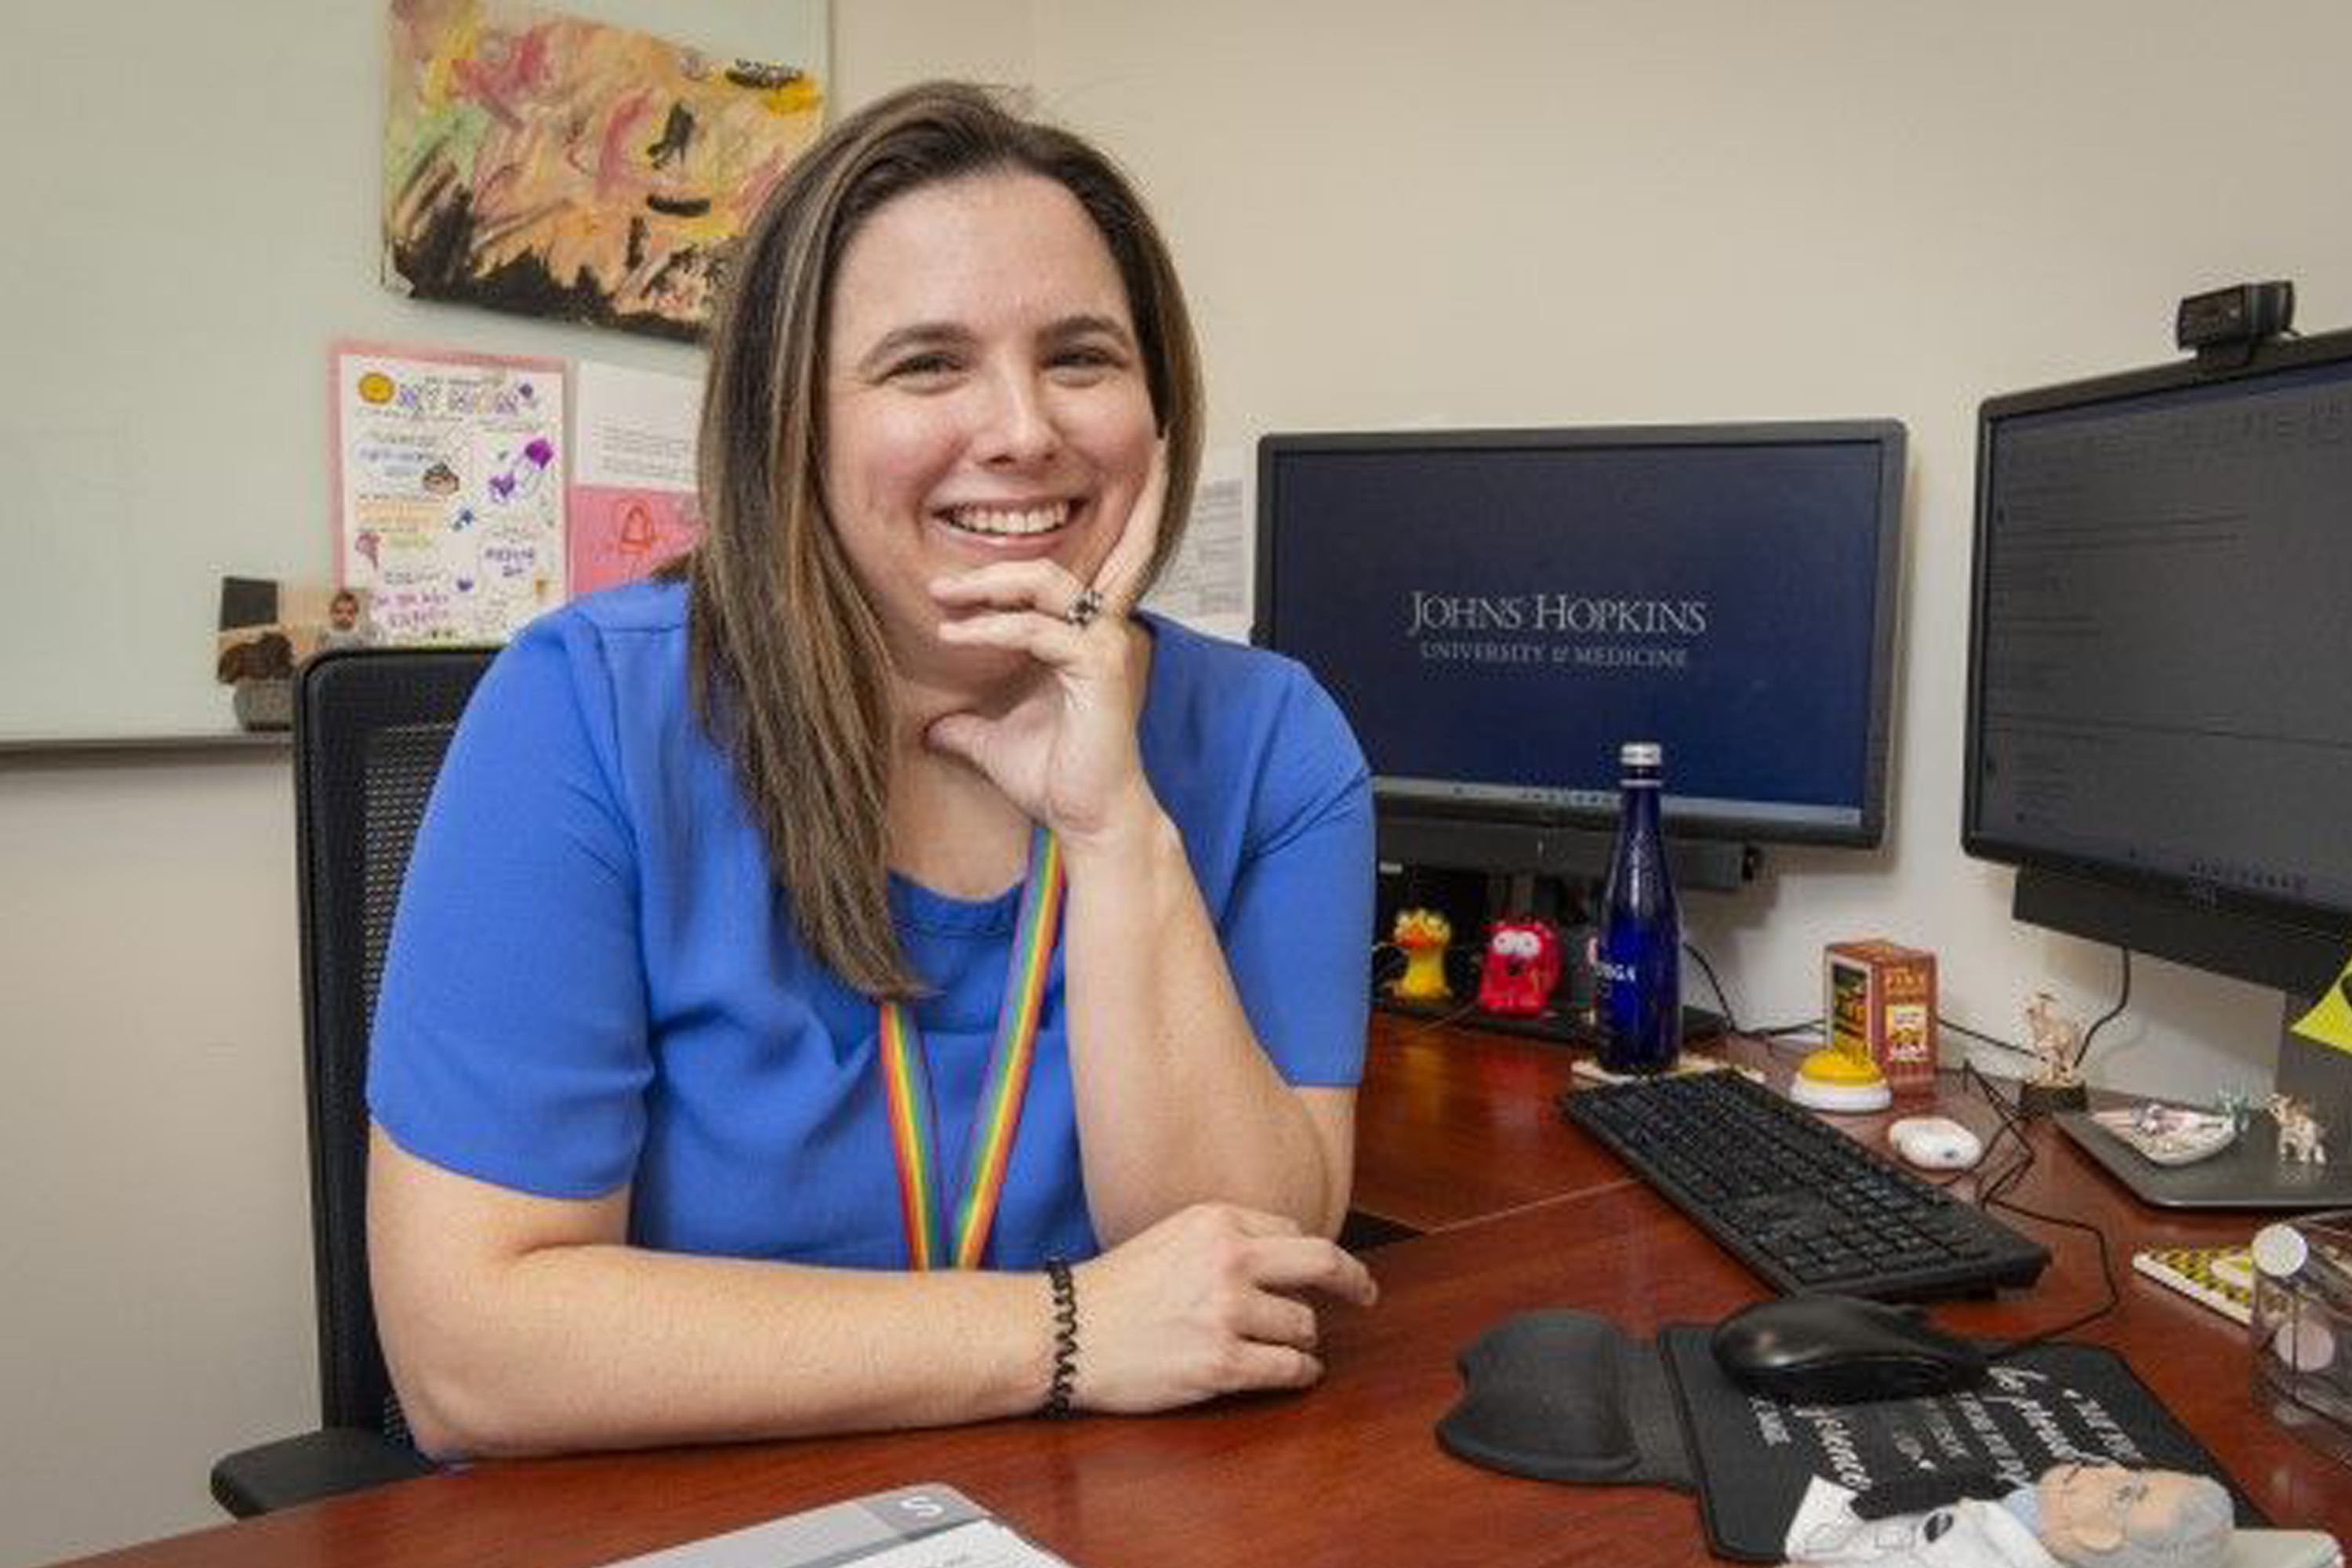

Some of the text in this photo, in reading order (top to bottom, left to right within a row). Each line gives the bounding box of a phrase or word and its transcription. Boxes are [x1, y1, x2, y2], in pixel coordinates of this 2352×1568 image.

[1408, 590, 1708, 636] JOHNS HOPKINS
[1421, 641, 1688, 668] UNIVERSITY & MEDICINE
